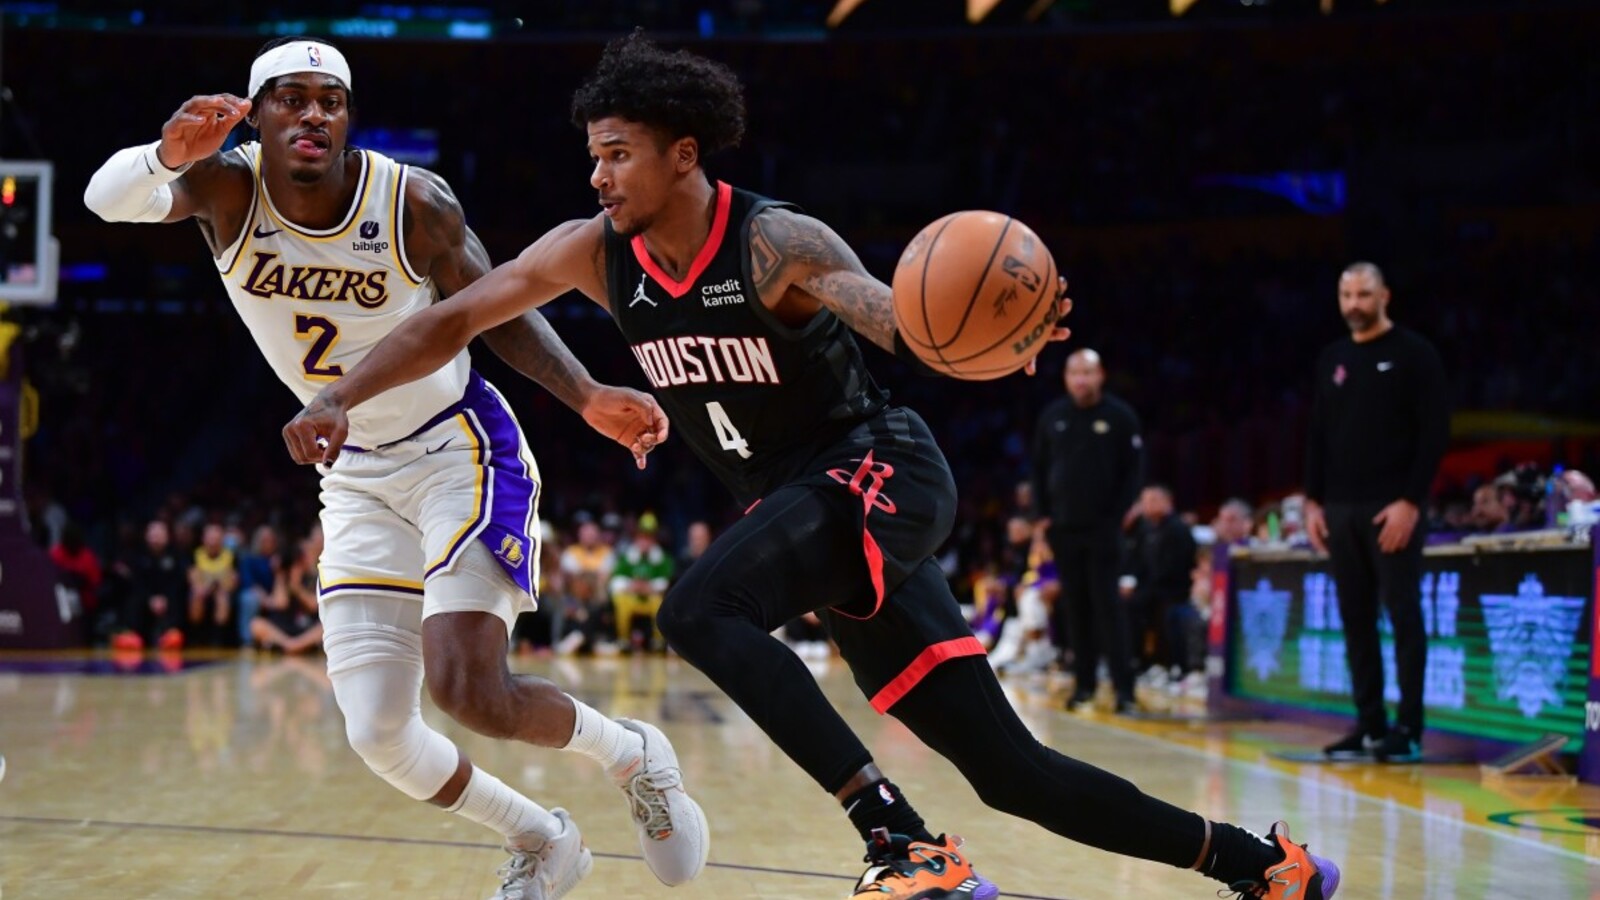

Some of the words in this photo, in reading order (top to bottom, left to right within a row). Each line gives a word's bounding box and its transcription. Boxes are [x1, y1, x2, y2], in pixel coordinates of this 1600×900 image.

[352, 240, 389, 254] bibigo
[241, 251, 389, 310] LAKERS
[701, 279, 741, 296] credit
[702, 292, 745, 308] karma
[293, 311, 345, 382] 2
[630, 336, 782, 389] HOUSTON
[705, 401, 754, 459] 4
